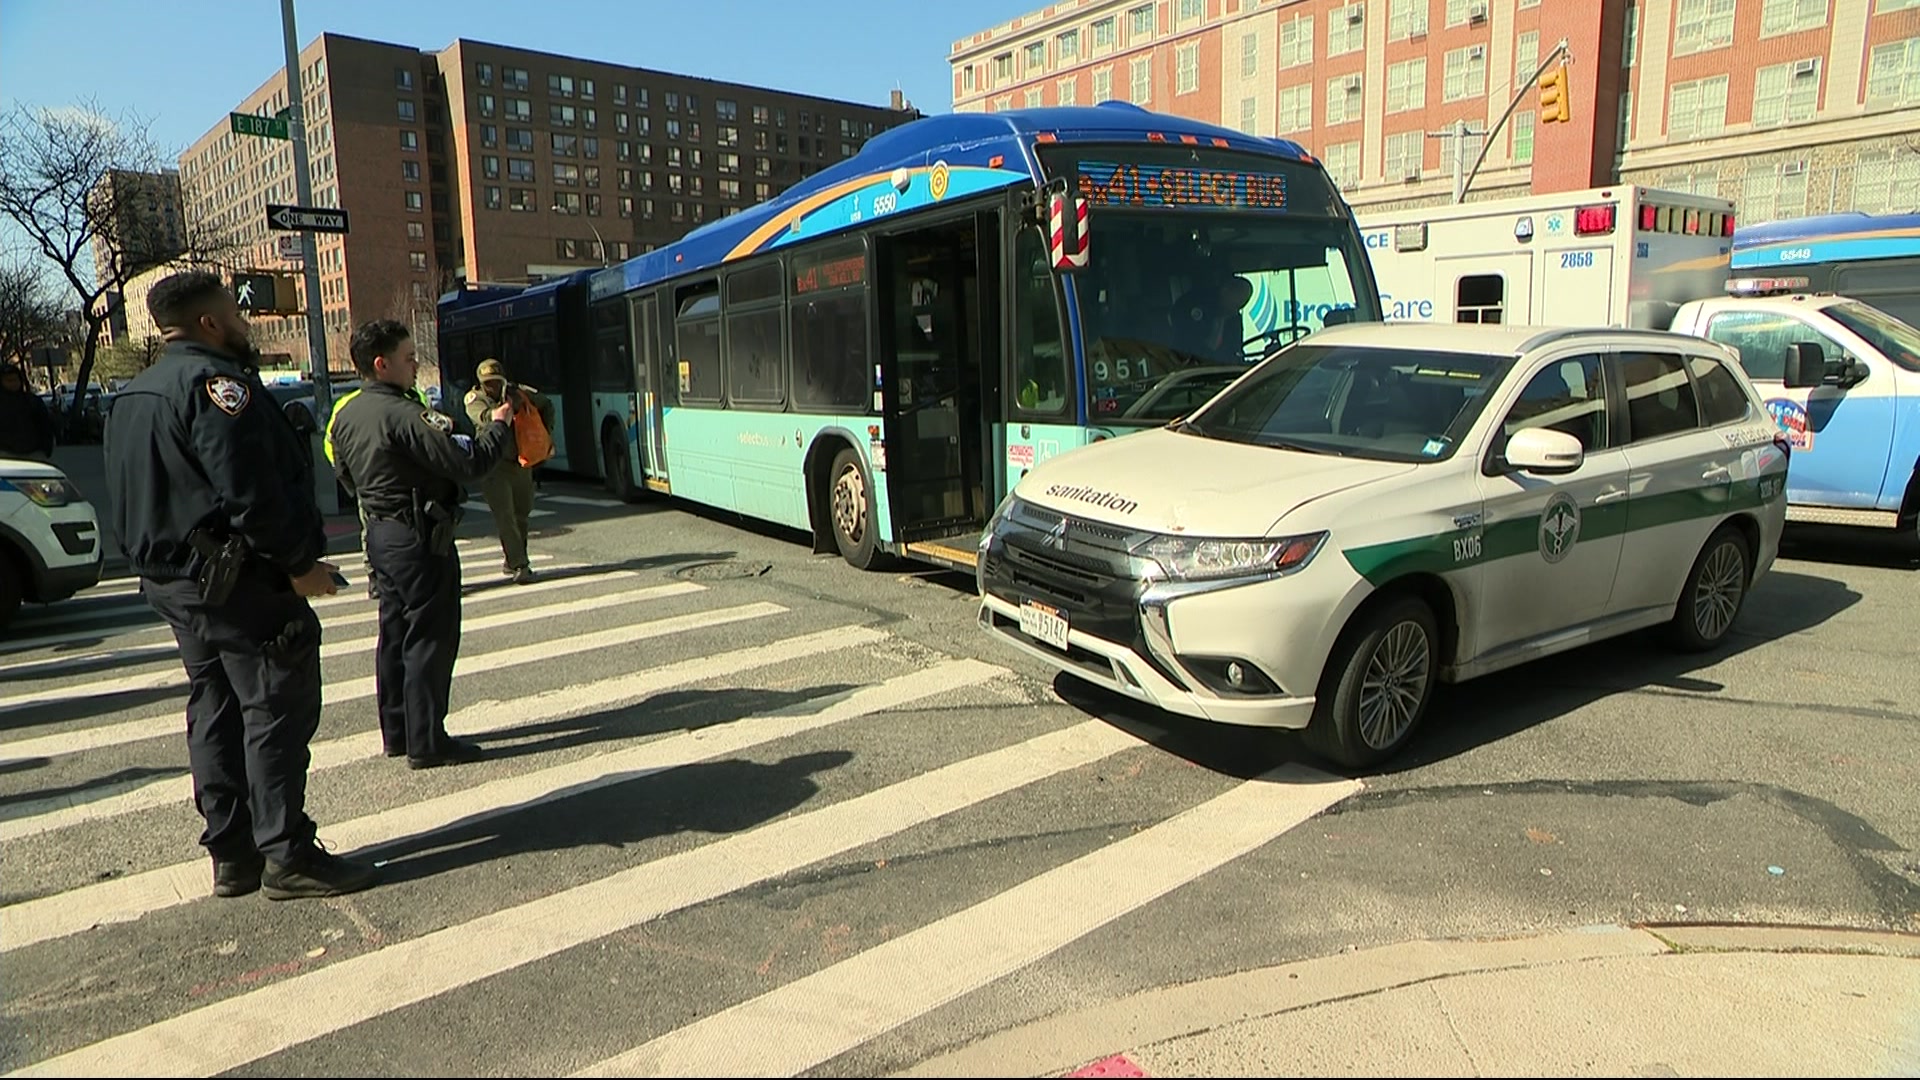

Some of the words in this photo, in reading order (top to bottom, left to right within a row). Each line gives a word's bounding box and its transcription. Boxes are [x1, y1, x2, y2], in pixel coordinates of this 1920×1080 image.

[237, 116, 245, 131] E
[250, 118, 270, 135] 187
[1247, 174, 1285, 208] BUS
[873, 192, 896, 216] 5550
[280, 212, 304, 225] ONE
[314, 215, 339, 226] WAY
[1561, 251, 1593, 269] 2858
[1046, 485, 1138, 514] sanitation
[1453, 535, 1481, 561] BX06
